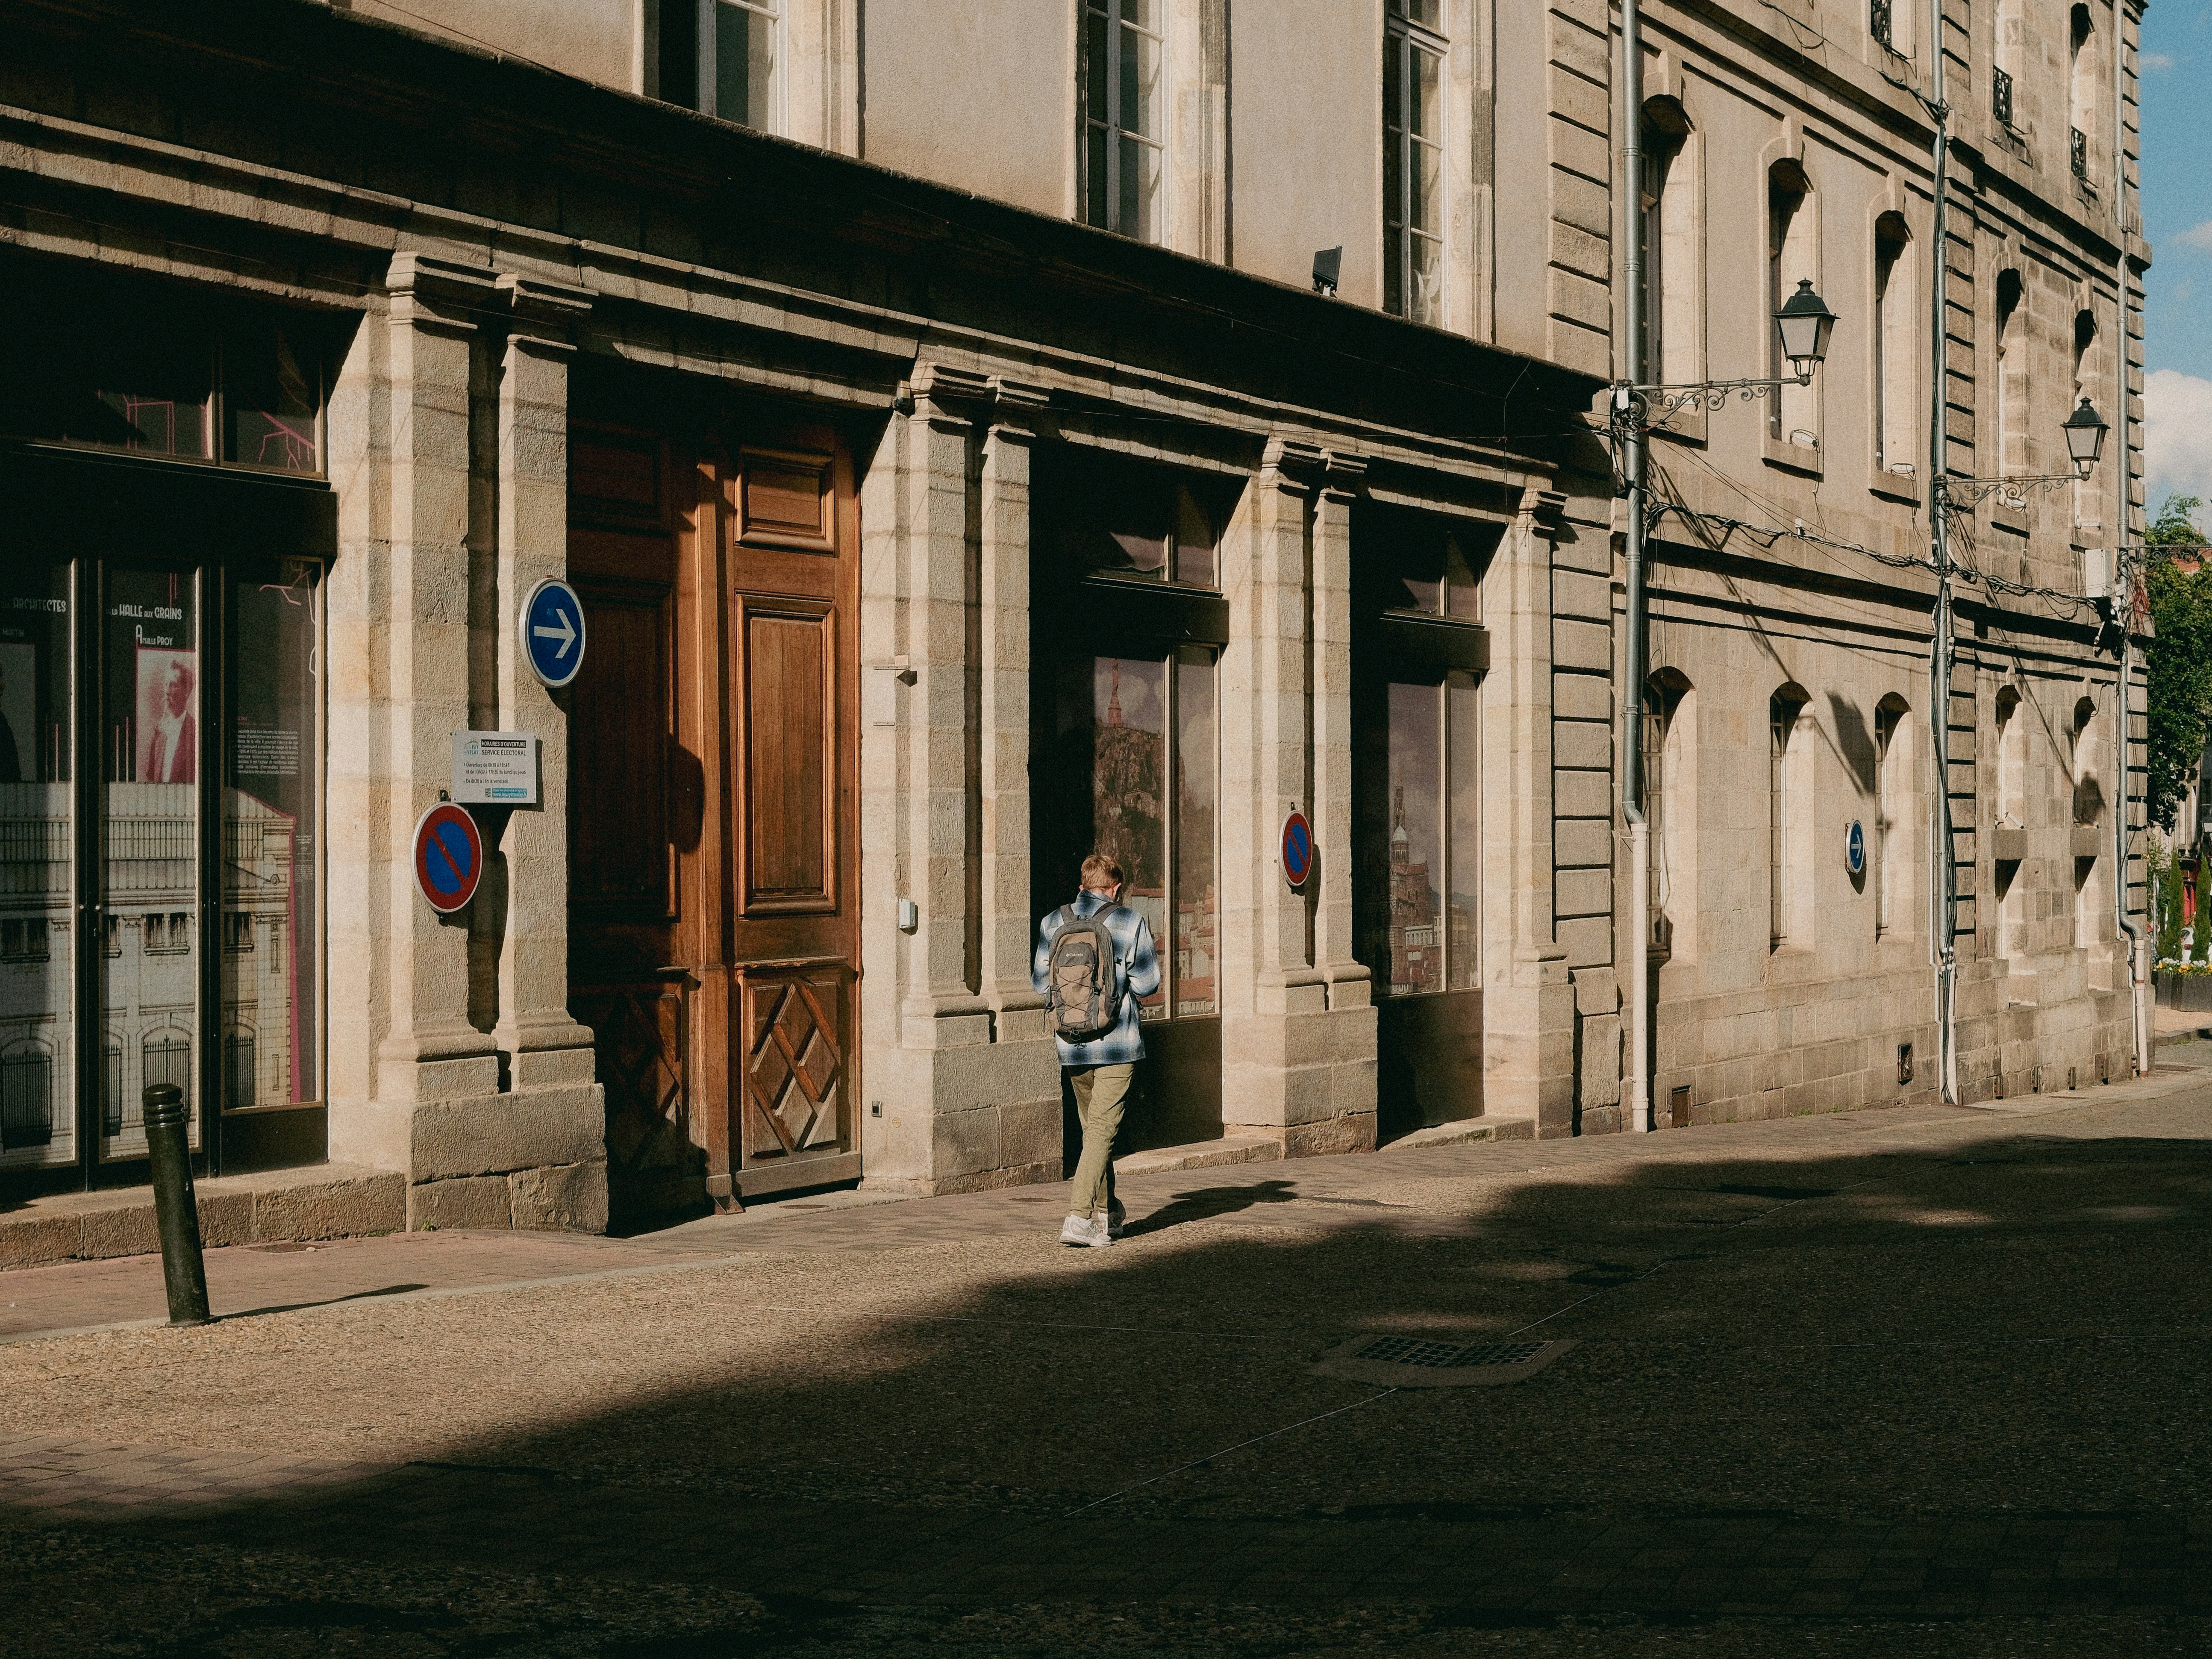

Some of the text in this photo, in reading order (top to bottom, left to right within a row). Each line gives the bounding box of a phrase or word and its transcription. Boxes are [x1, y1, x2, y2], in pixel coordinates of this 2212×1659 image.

[13, 597, 67, 612] ARCHITECTES
[119, 603, 143, 618] HALLE
[144, 610, 153, 618] AUX
[154, 606, 182, 621] GRAINS
[157, 635, 174, 646] PROY
